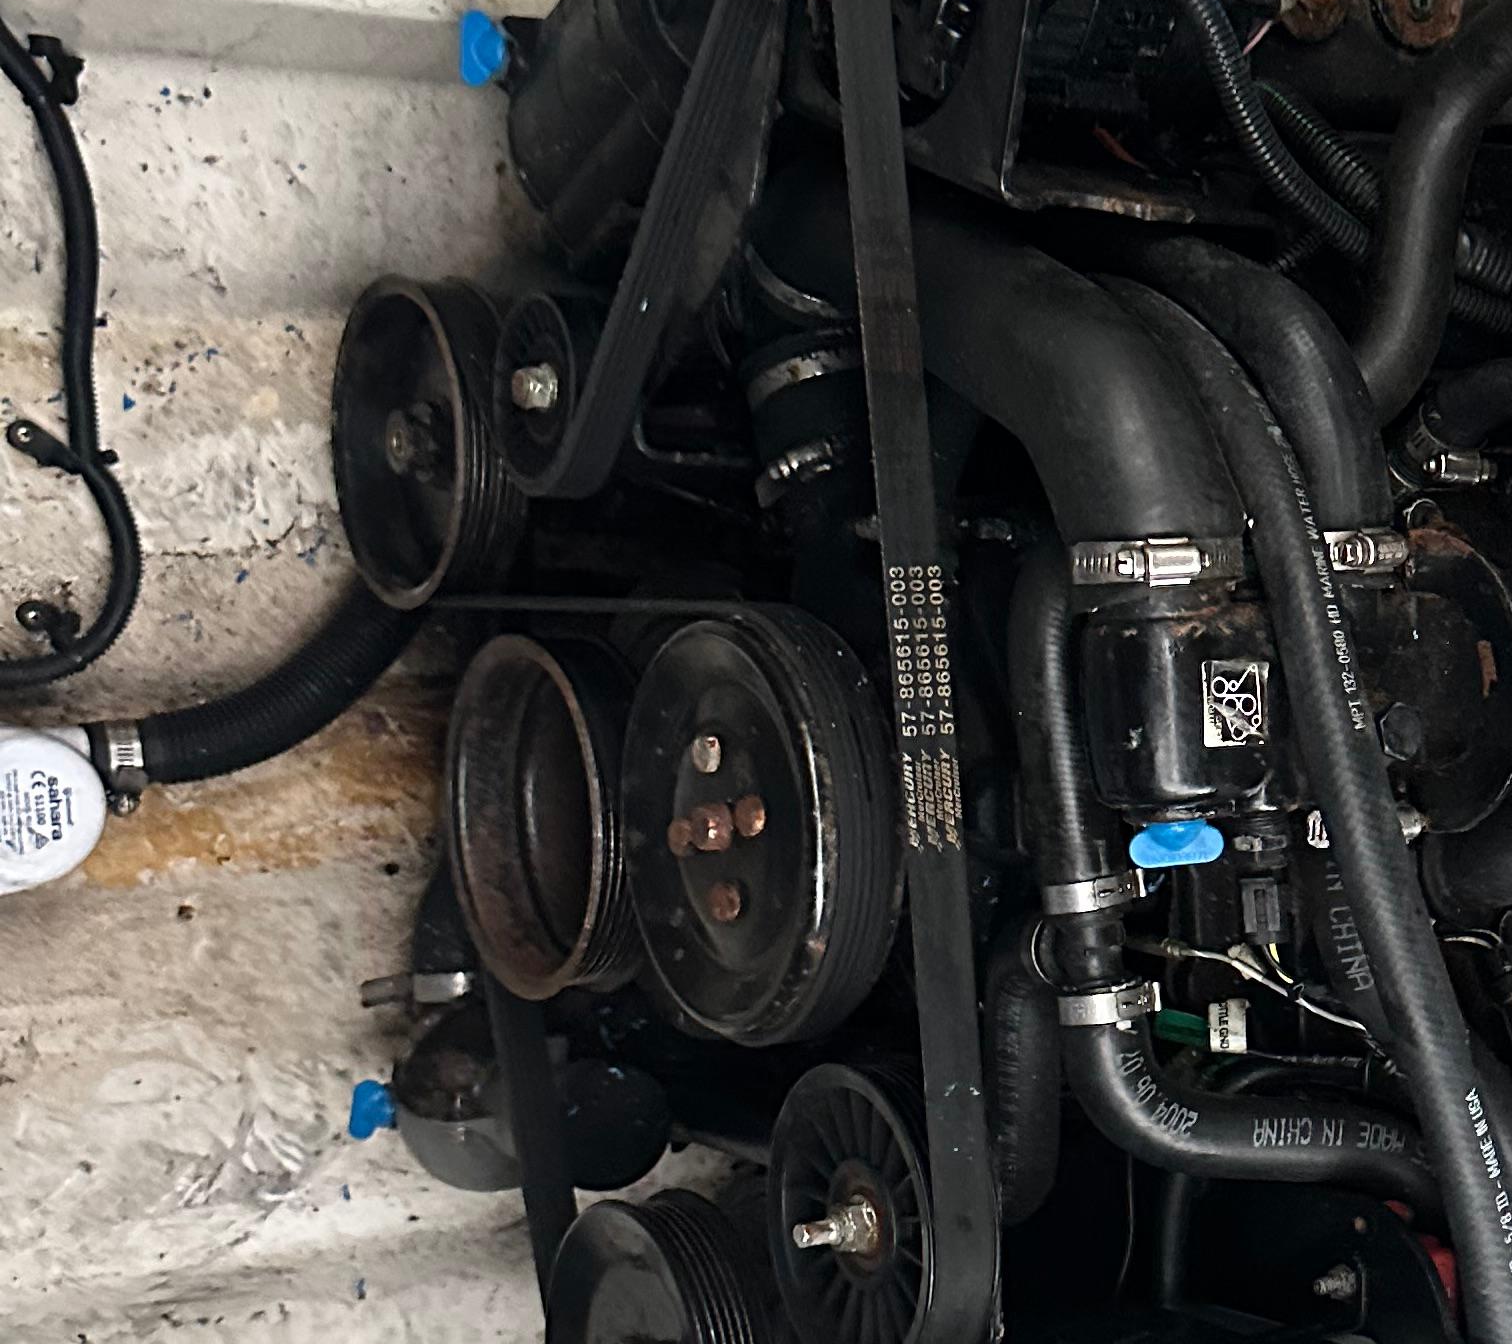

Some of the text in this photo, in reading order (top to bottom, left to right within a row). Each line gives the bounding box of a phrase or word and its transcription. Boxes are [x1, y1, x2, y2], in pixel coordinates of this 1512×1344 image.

[889, 565, 917, 738] 57-865615-003
[908, 565, 936, 737] 57-865615-003
[928, 565, 955, 736] 57-865615-003
[47, 776, 63, 841] sahara
[1329, 905, 1375, 991] CHINA
[1465, 1088, 1483, 1121] USA
[1474, 1119, 1488, 1136] IN
[1252, 1118, 1313, 1148] CHINA
[1321, 1118, 1345, 1147] IN
[1480, 1135, 1500, 1179] MADE
